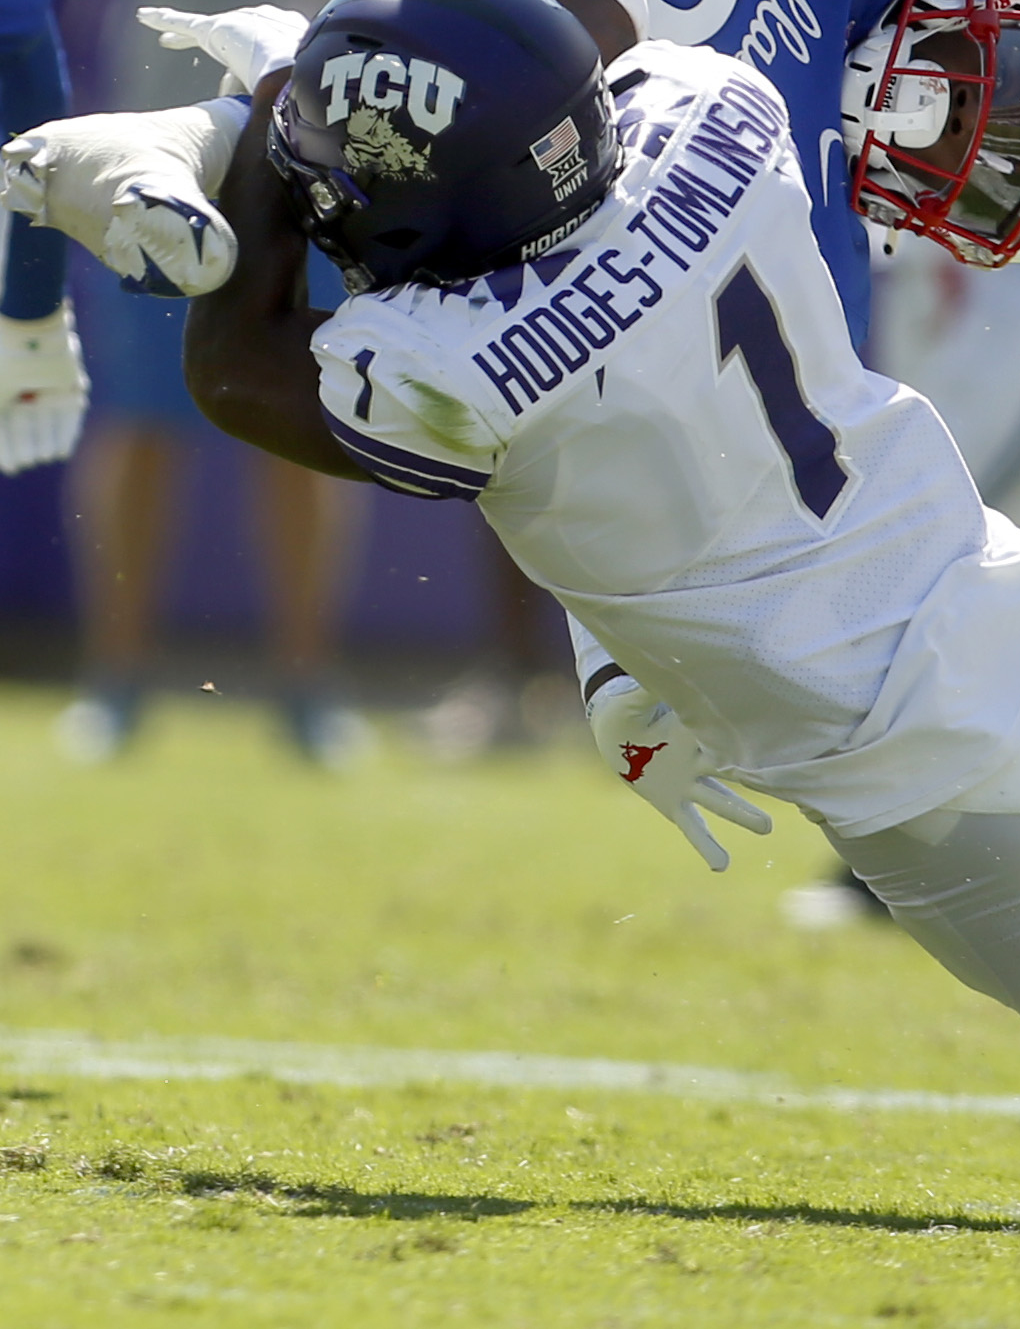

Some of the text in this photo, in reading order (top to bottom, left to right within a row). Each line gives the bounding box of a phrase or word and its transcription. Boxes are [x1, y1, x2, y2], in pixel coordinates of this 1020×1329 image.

[320, 52, 464, 136] TCU
[554, 167, 589, 202] UNITY
[472, 72, 787, 417] HODGES-TOMLINSON
[350, 345, 377, 424] 1
[709, 252, 860, 535] 1
